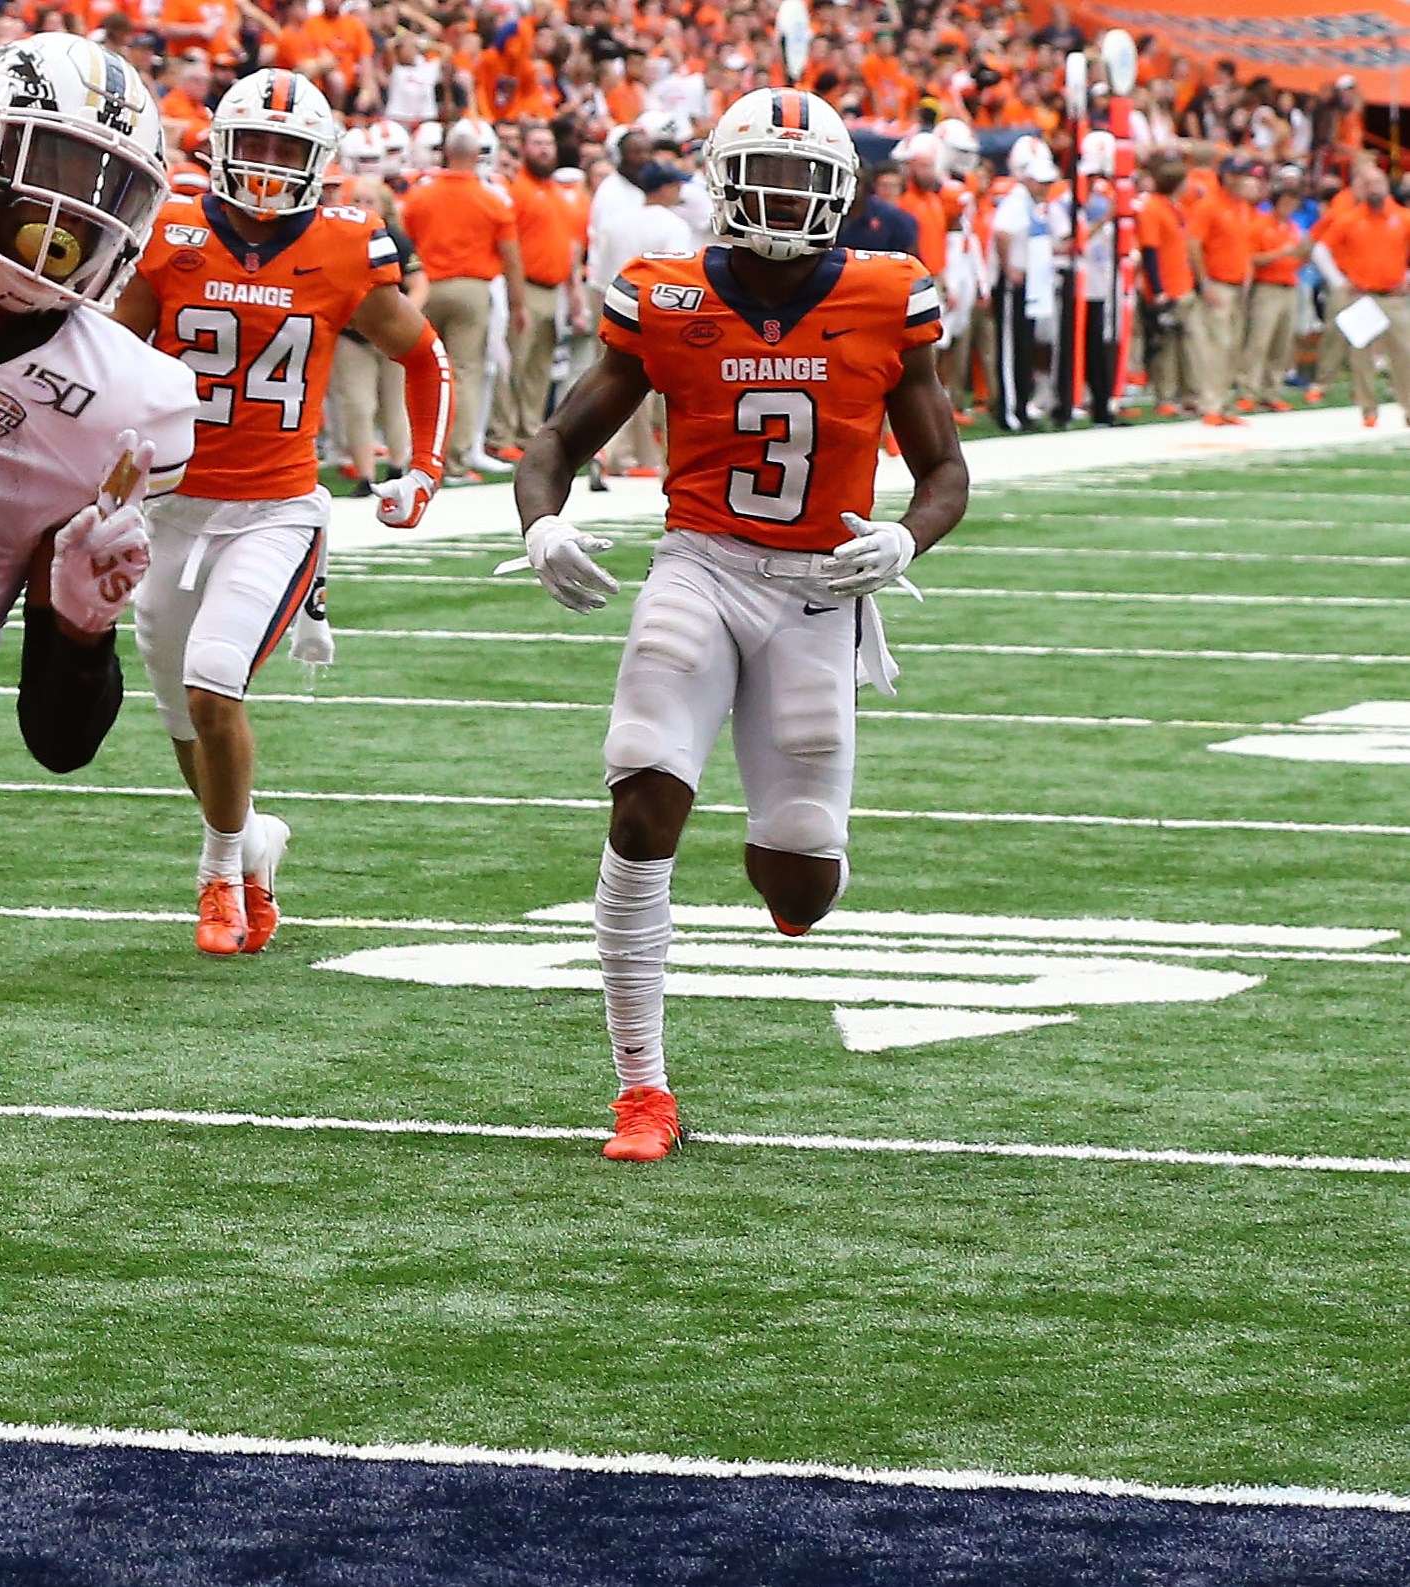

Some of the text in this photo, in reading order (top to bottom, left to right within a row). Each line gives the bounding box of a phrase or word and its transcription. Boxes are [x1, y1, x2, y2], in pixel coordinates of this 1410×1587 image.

[166, 225, 209, 247] 150
[204, 280, 294, 309] ORANGE
[651, 284, 705, 311] 150
[762, 320, 781, 342] S
[176, 305, 314, 431] 24
[720, 357, 828, 382] ORANGE
[21, 363, 97, 419] 150
[725, 388, 818, 526] 3
